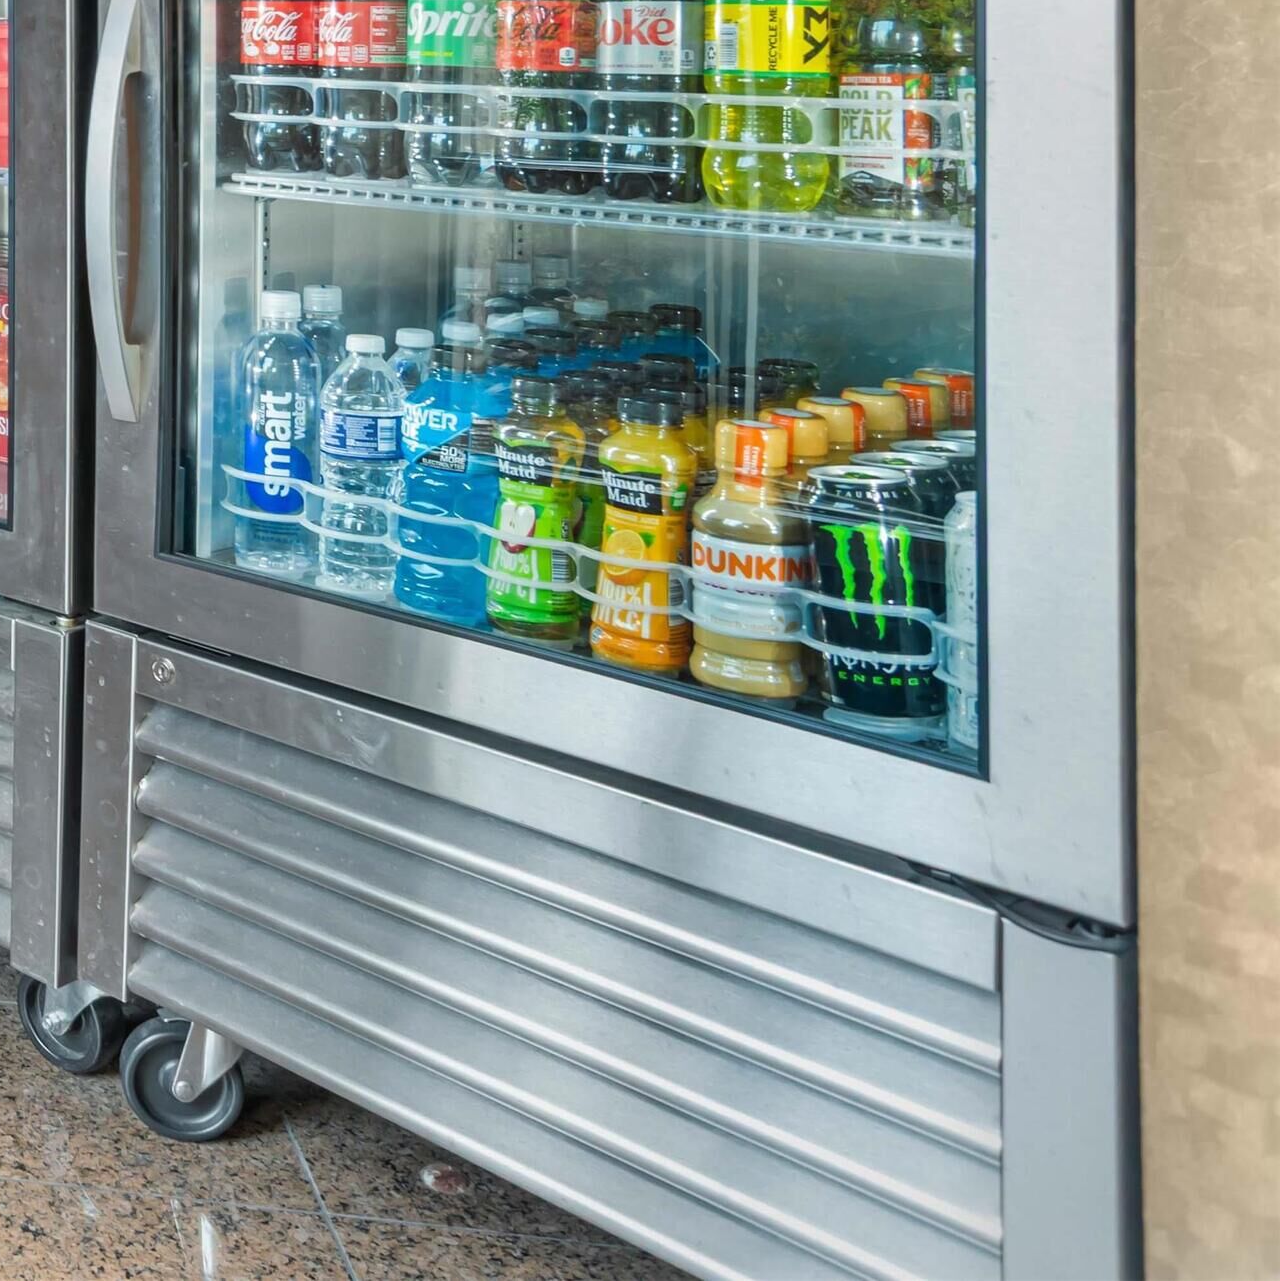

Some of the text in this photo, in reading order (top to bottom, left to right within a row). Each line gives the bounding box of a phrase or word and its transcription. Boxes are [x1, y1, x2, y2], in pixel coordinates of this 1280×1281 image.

[634, 5, 667, 18] Diet
[599, 8, 676, 46] oke
[768, 6, 778, 71] RECYCLE ME
[841, 115, 894, 142] PEAK
[294, 392, 307, 440] water
[263, 390, 293, 497] smart
[439, 455, 467, 465] MORE
[607, 488, 649, 509] Maid
[838, 671, 931, 687] ENERGY
